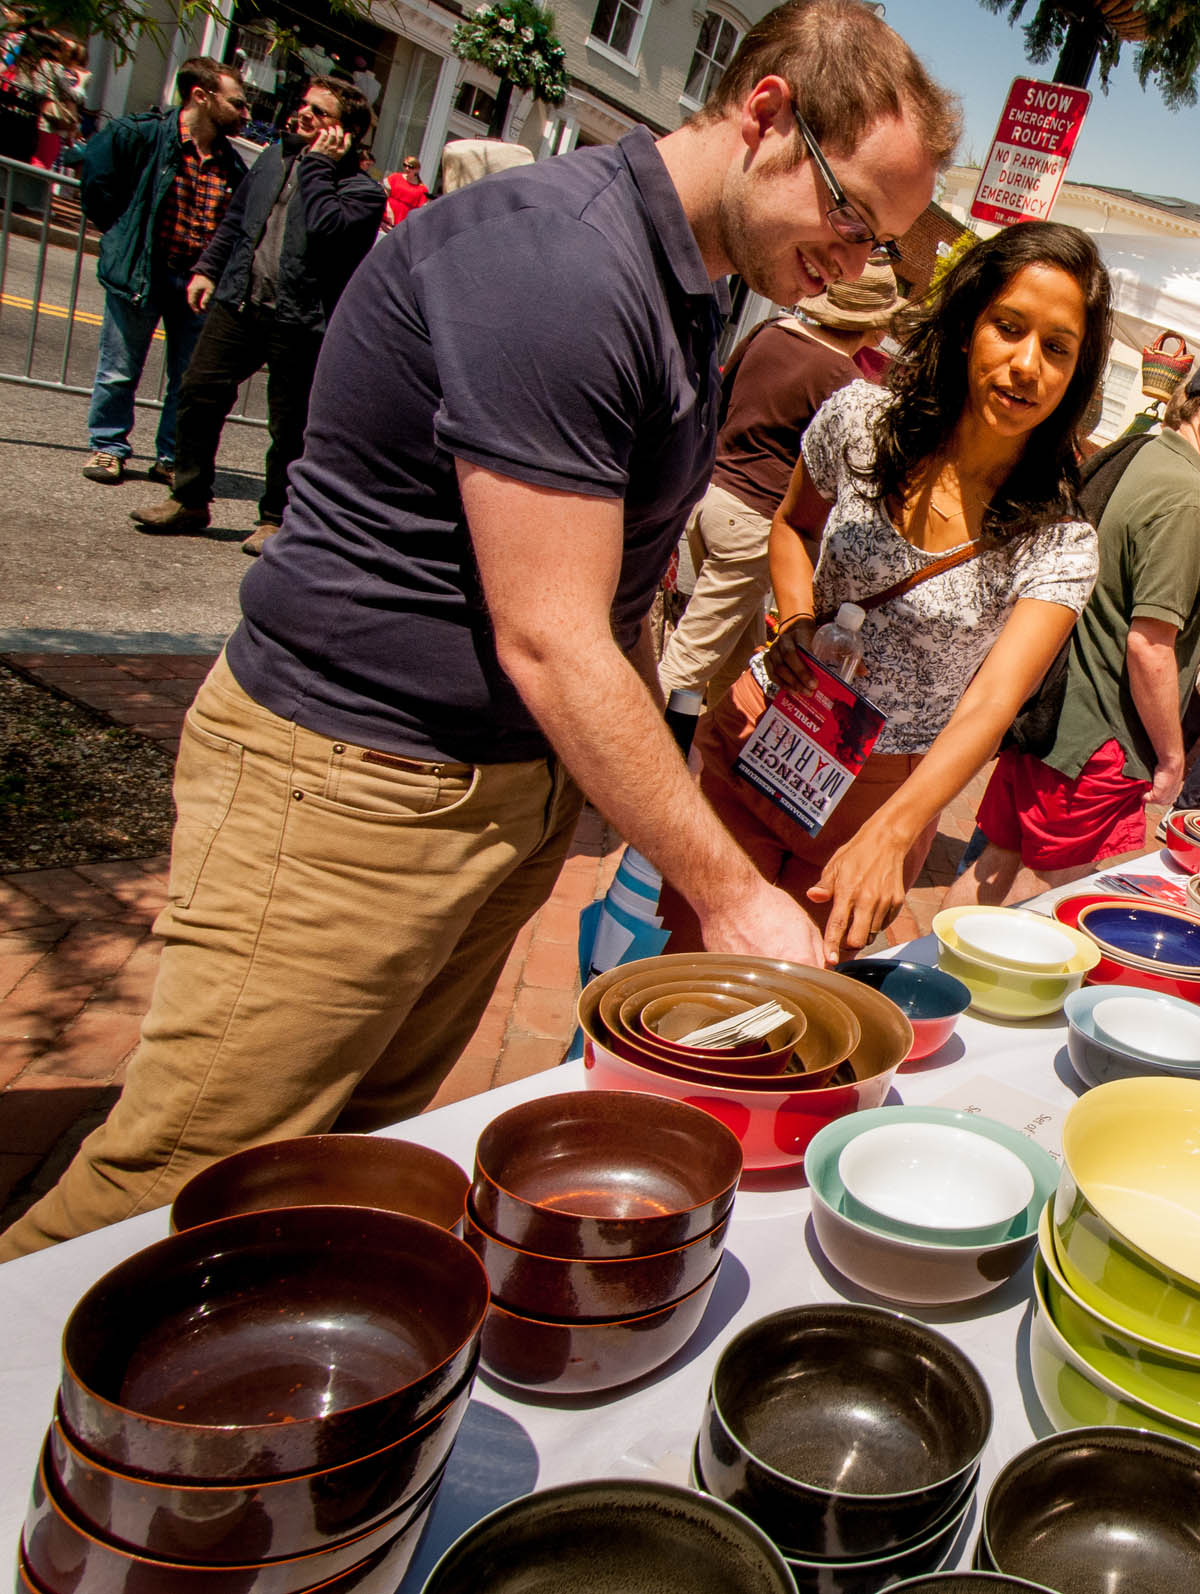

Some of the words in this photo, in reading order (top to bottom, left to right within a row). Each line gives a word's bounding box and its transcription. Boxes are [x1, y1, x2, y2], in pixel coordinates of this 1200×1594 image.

[1024, 88, 1073, 113] SNOW
[1008, 108, 1075, 133] EMERGENCY
[1011, 126, 1059, 150] ROUTE
[995, 149, 1009, 163] NO
[1012, 152, 1058, 175] PARKING
[998, 169, 1041, 191] DURING
[980, 185, 1048, 214] EMERGENCY
[758, 719, 845, 798] MARKET
[750, 742, 829, 811] FRENCH
